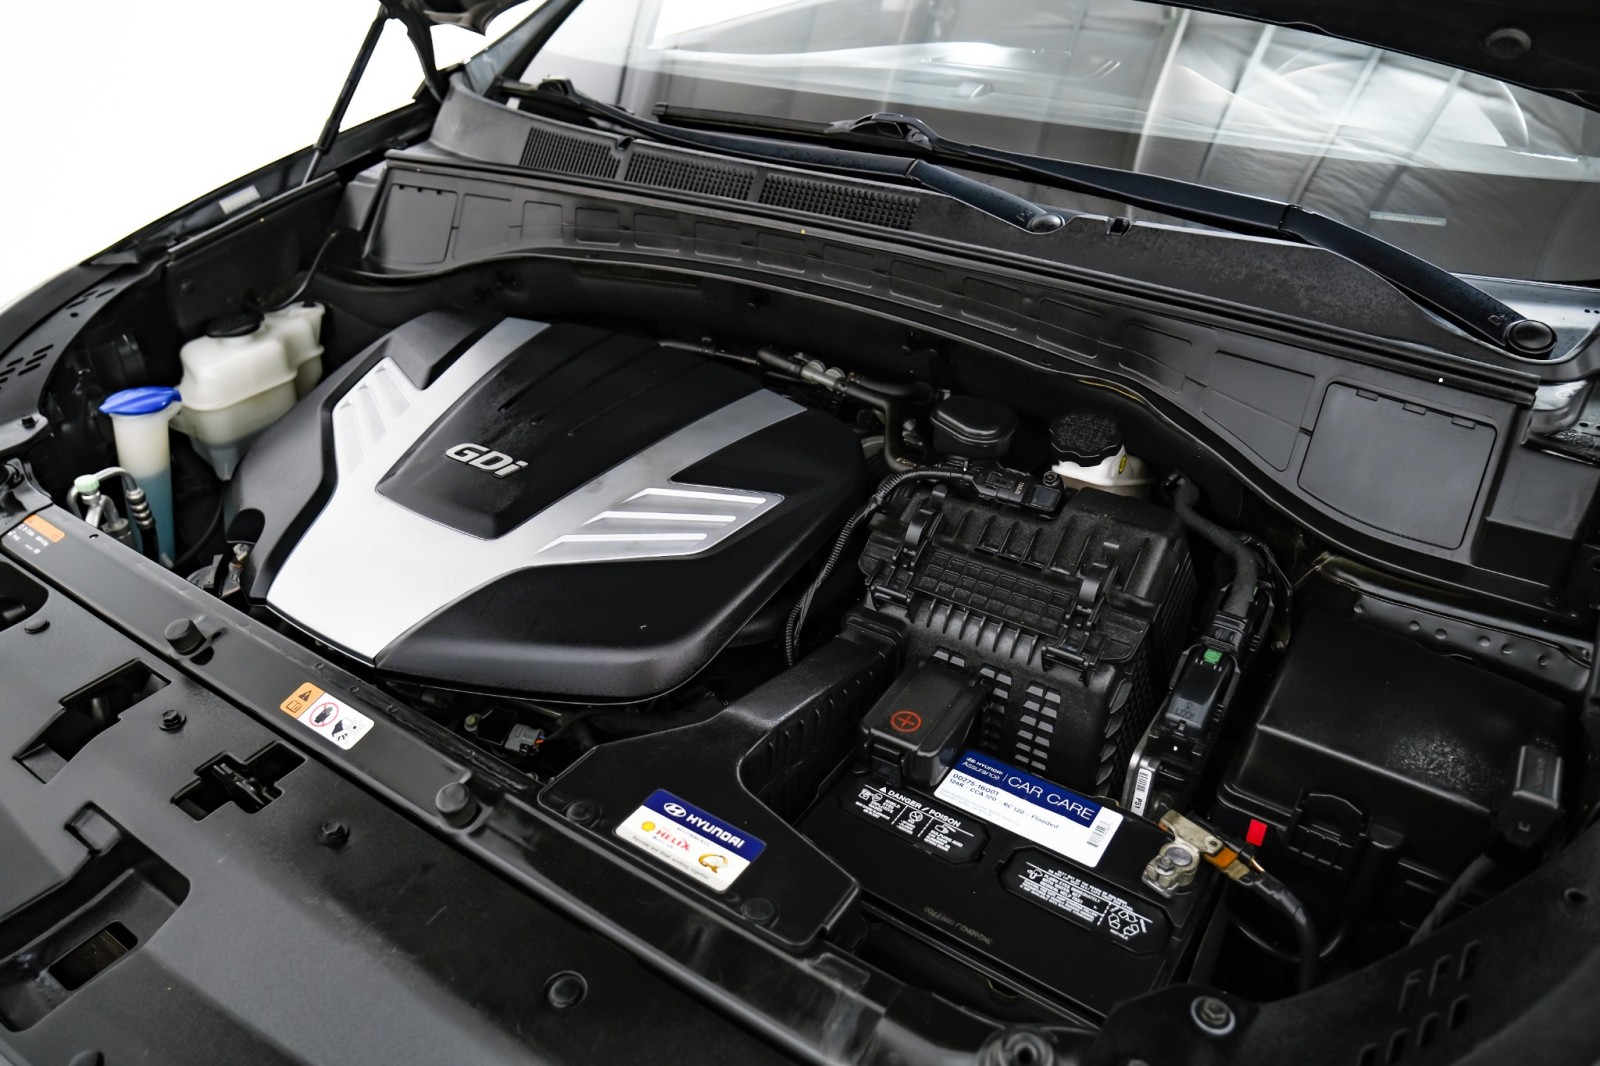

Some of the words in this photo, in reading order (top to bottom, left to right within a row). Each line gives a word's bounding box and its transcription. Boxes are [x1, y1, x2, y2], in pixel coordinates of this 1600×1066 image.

[445, 443, 528, 478] GDi
[962, 761, 1001, 781] Assurance
[976, 760, 1003, 775] HYUNDAI
[952, 773, 1000, 796] 00275-16001
[969, 787, 985, 797] CCA
[887, 789, 922, 809] DANGER
[928, 809, 962, 828] POISON
[1008, 776, 1043, 798] CAR
[1046, 793, 1095, 821] CARE
[656, 829, 690, 852] HELIX
[685, 813, 745, 849] HYUNDAI
